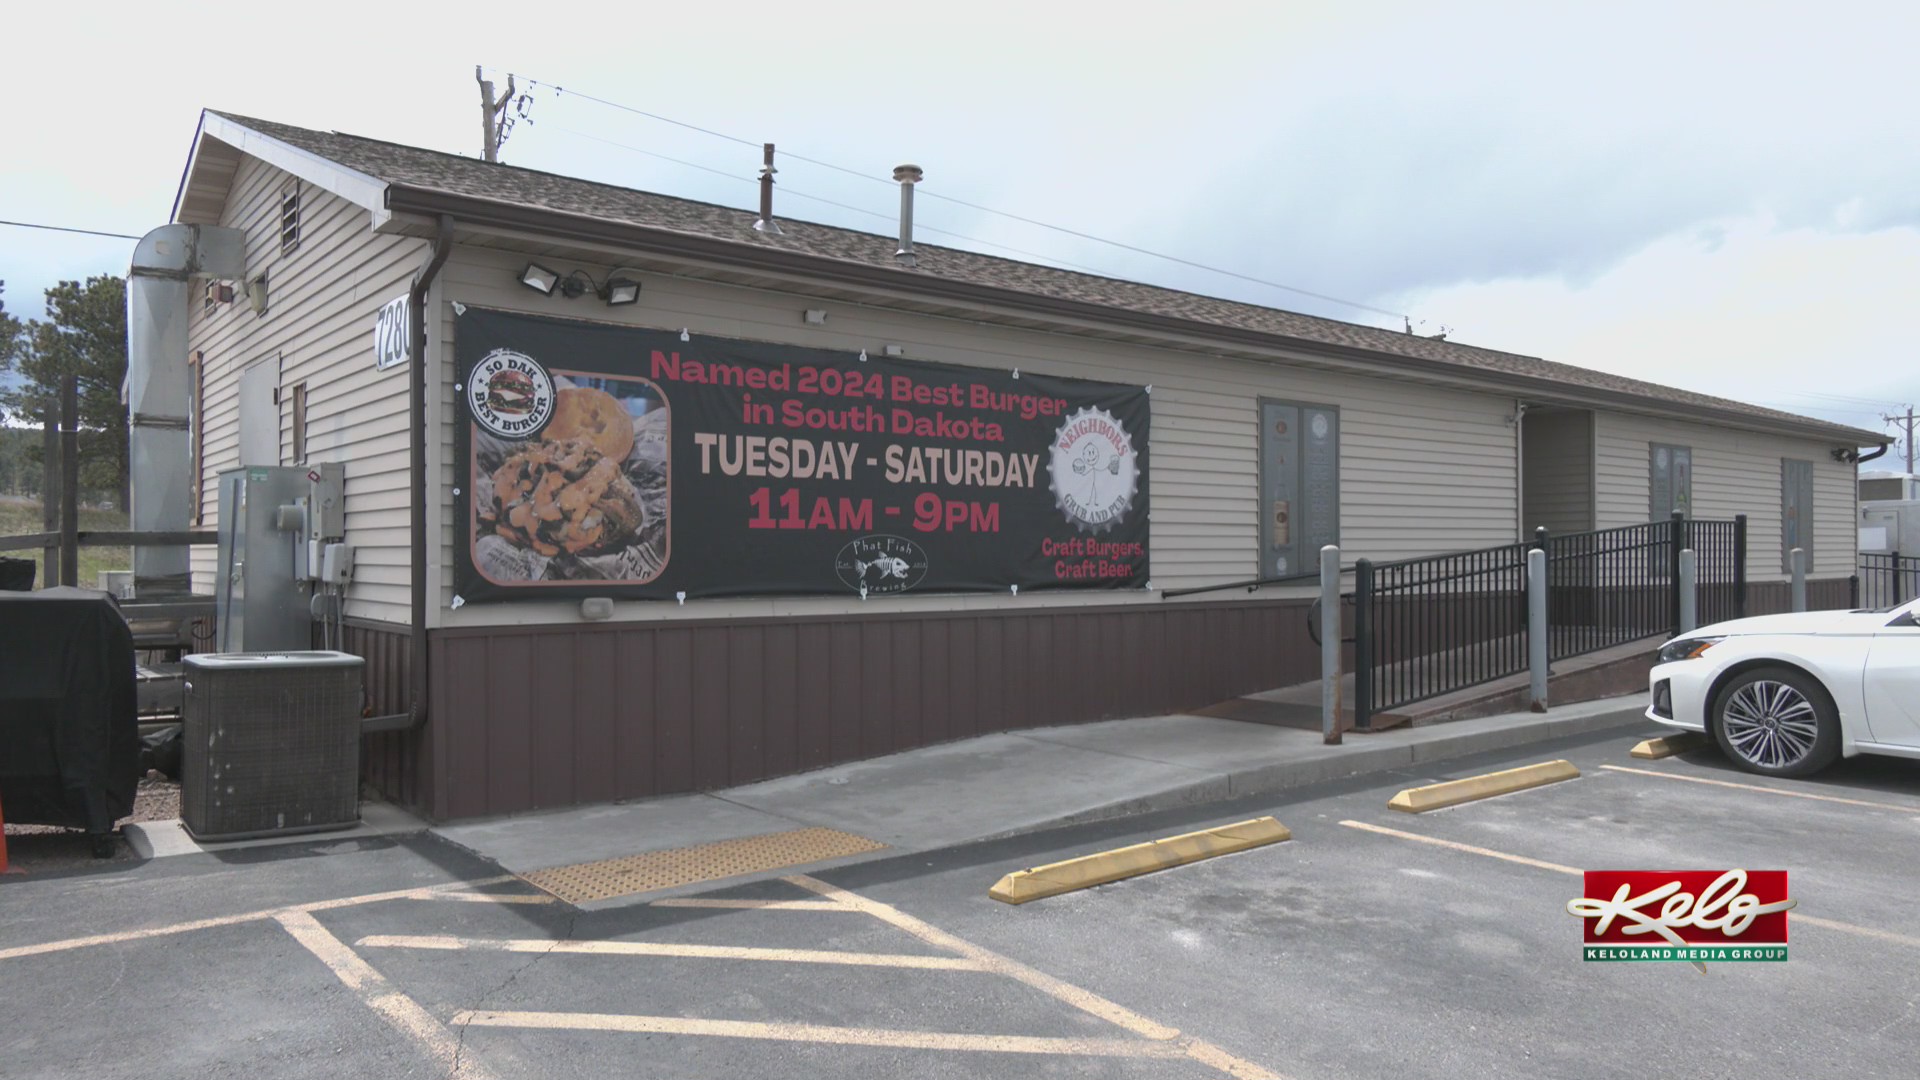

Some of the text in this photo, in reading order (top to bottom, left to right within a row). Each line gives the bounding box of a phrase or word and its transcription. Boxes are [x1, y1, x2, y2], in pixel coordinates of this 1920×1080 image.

[485, 358, 538, 380] SO DAK
[651, 350, 1067, 420] Named 2024 Best Burger
[475, 390, 548, 432] BEST BURGER
[743, 393, 1004, 442] in South Dakota
[1058, 418, 1128, 457] NEIGHBORS
[695, 432, 859, 481] TUESDAY
[885, 444, 1039, 488] SATURDAY
[748, 487, 873, 530] 11AM
[912, 492, 999, 532] 9PM
[1063, 493, 1126, 523] GRUB AND PUB
[853, 538, 912, 555] Phat Fish
[1042, 537, 1144, 560] Craft Burgers.
[860, 579, 907, 591] Brewing
[1055, 559, 1133, 579] Craft Beer.
